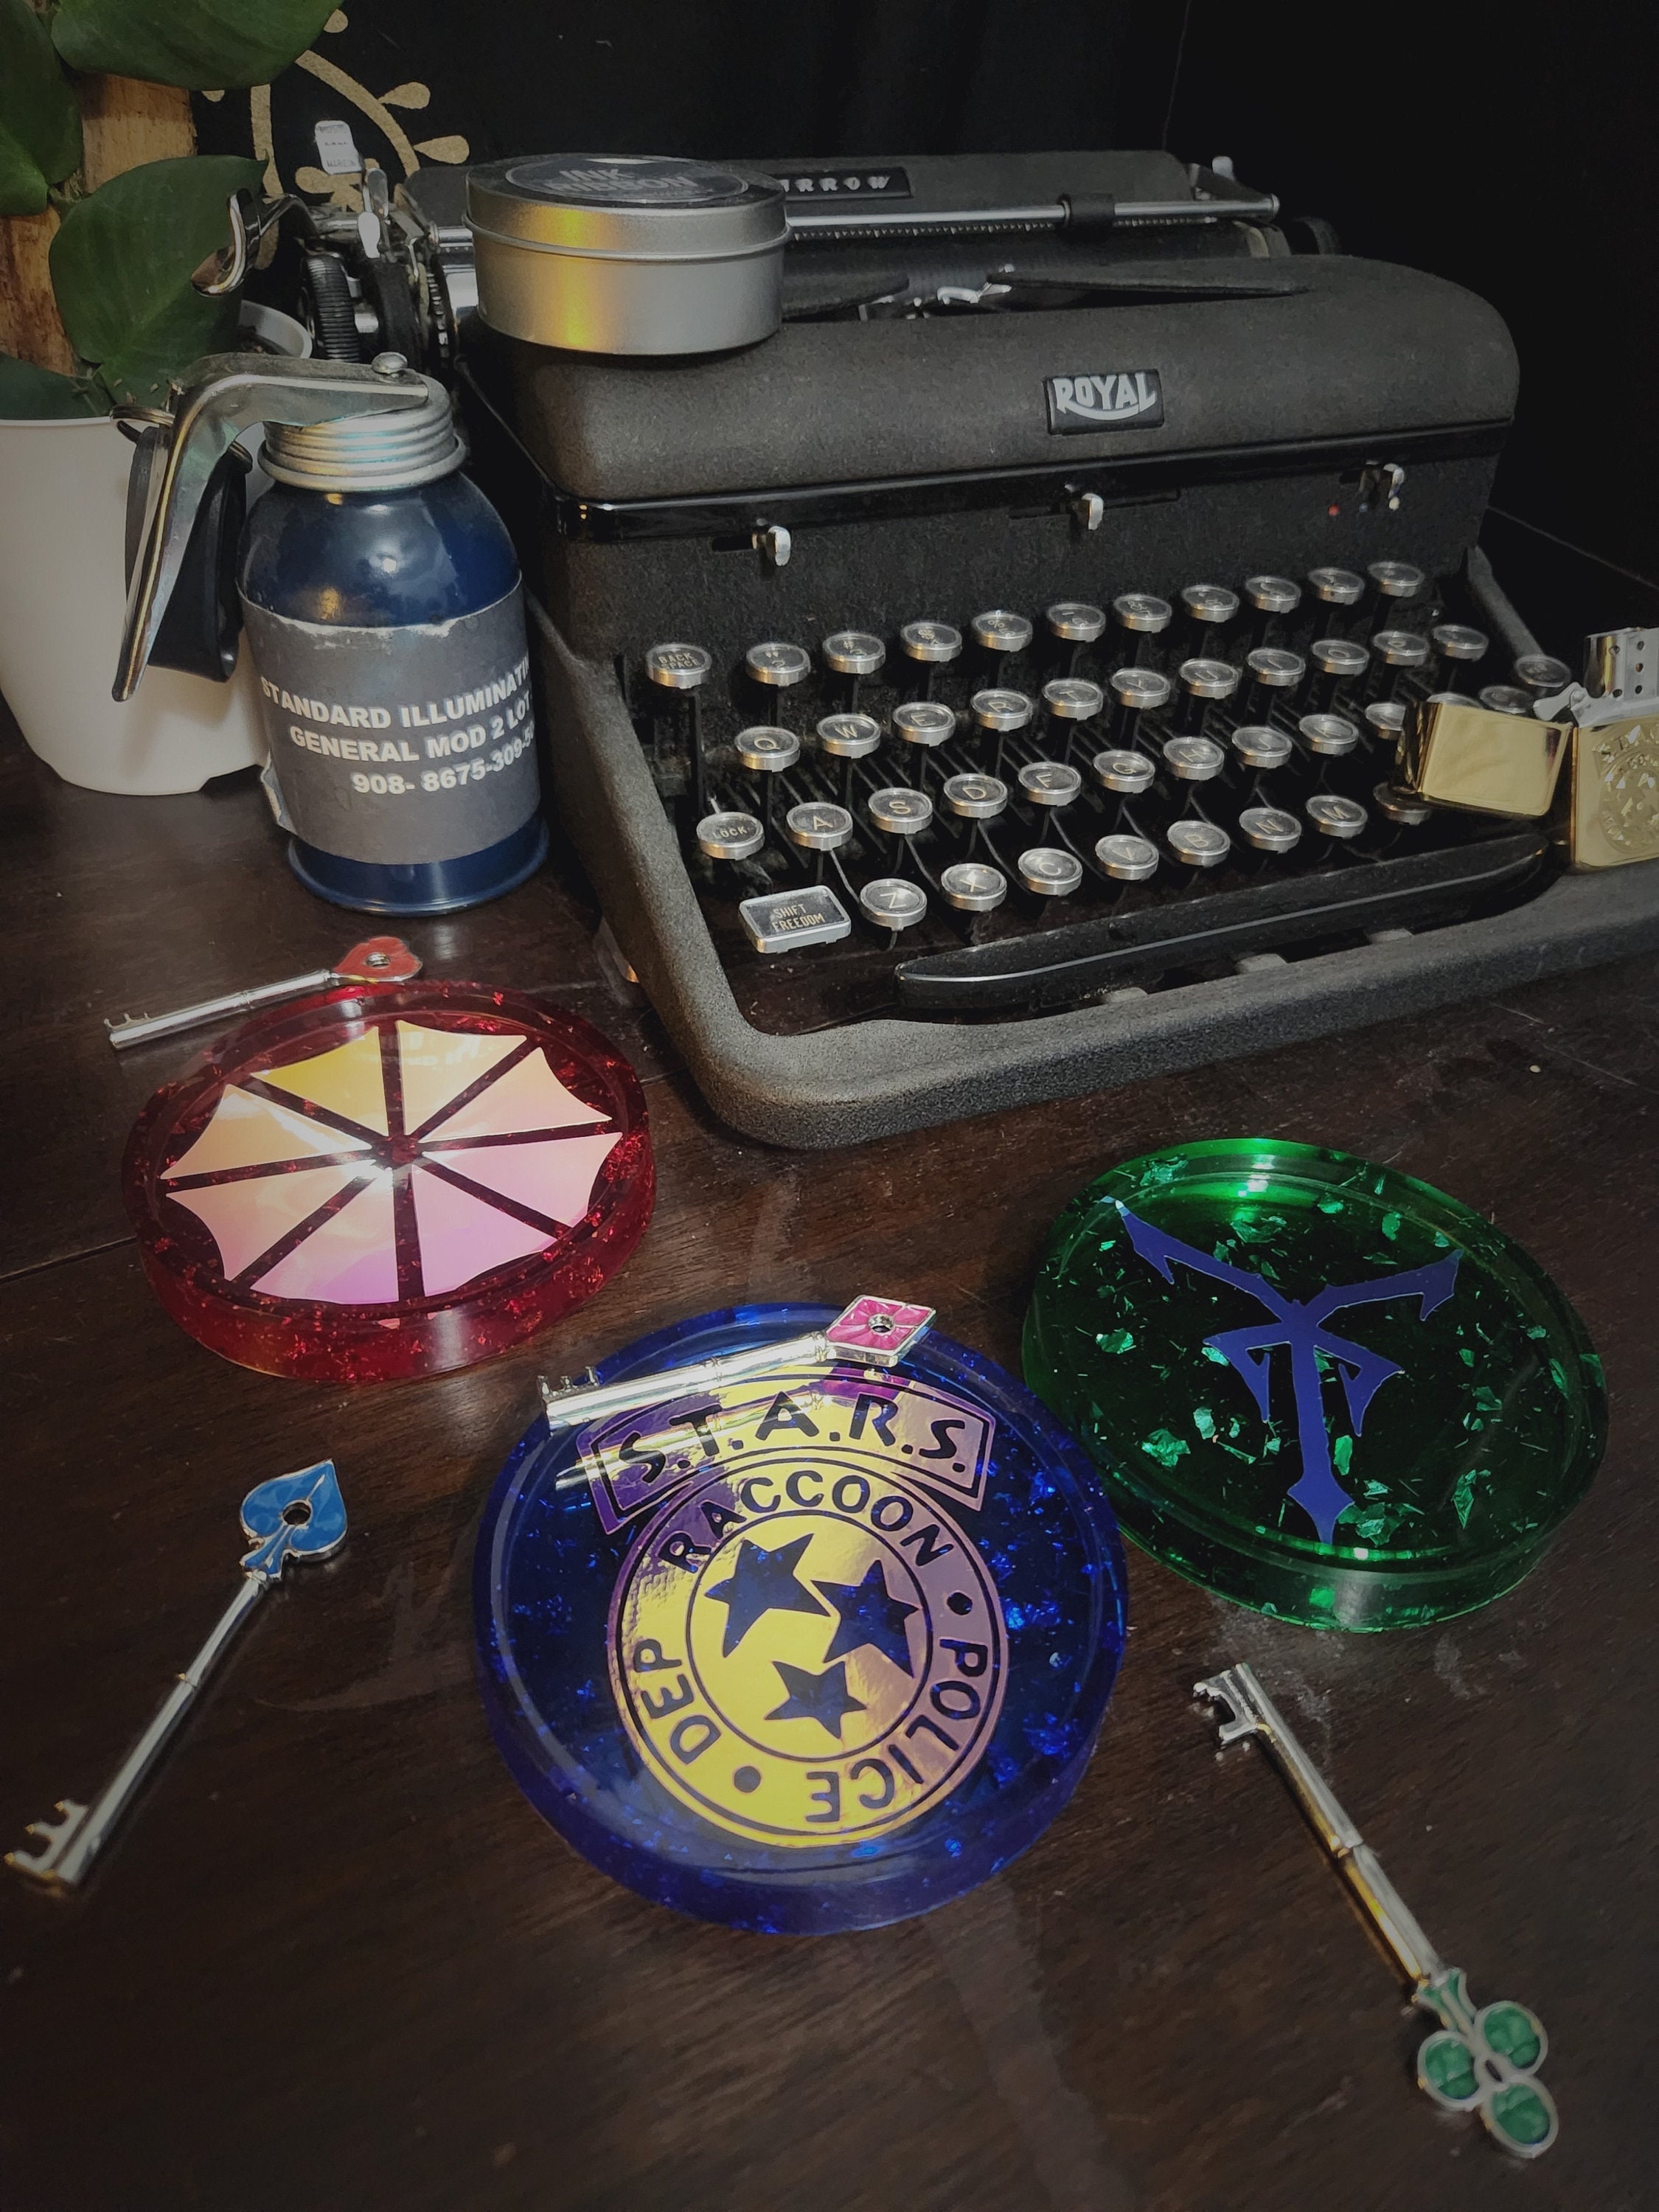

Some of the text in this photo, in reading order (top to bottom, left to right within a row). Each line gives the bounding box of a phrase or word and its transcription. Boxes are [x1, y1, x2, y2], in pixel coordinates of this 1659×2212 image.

[560, 168, 635, 182] INK
[544, 176, 700, 192] RIBBON
[1052, 372, 1157, 420] ROYAL
[658, 653, 693, 664] BACK
[261, 675, 391, 729] STANDARD
[987, 702, 1013, 714] R
[911, 713, 936, 726] E
[834, 723, 858, 738] W
[289, 726, 420, 762] GENERAL
[426, 726, 486, 759] MOD
[490, 715, 505, 740] 2
[753, 737, 781, 751] Q
[1179, 748, 1207, 762] H
[1111, 762, 1137, 774] G
[352, 772, 416, 795] 908-
[1036, 773, 1052, 788] F
[961, 786, 987, 800] D
[888, 799, 911, 815] S
[1321, 805, 1351, 820] M
[812, 815, 834, 831] A
[1255, 819, 1284, 834] N
[713, 825, 748, 840] LOCK
[1184, 834, 1209, 849] B
[1038, 861, 1062, 876] C
[880, 892, 907, 909] Z
[773, 903, 807, 919] SHIFT
[771, 913, 825, 933] FREEDOM
[617, 1391, 966, 1484] S.T.A.R.S.
[658, 1470, 956, 1574] RACCOON
[633, 1638, 722, 1765] DEP
[804, 1638, 989, 1823] POLICE
